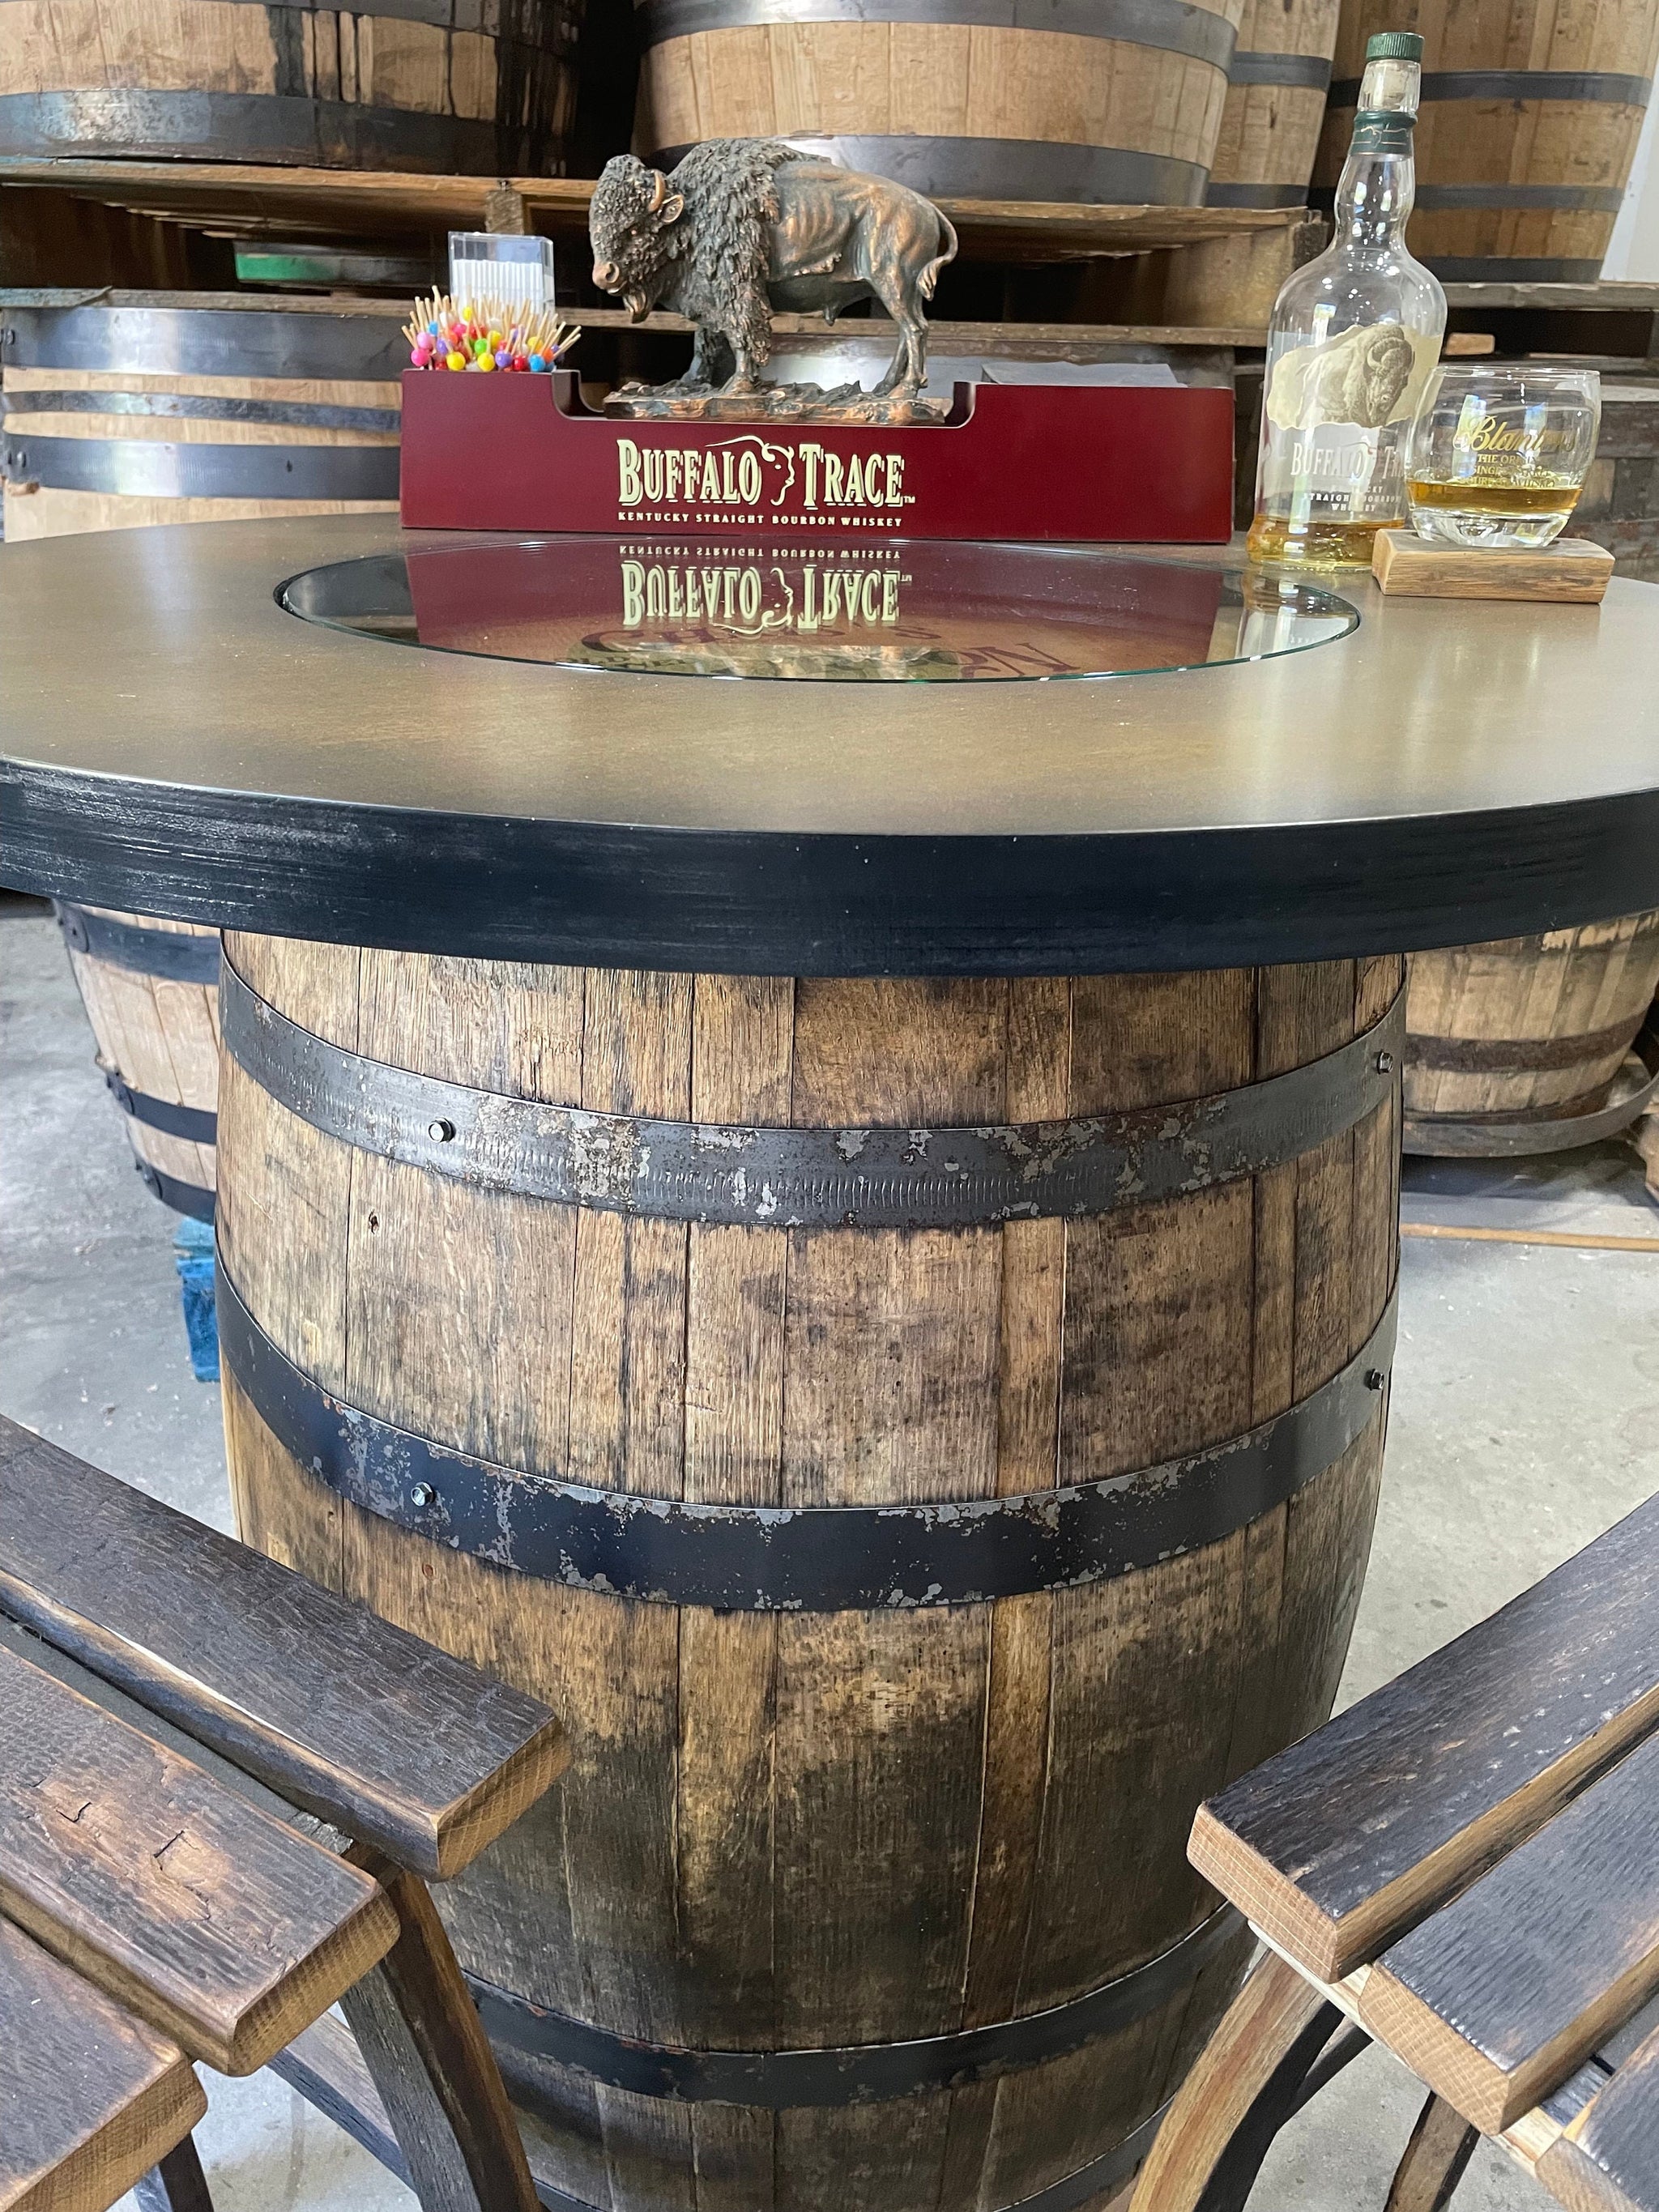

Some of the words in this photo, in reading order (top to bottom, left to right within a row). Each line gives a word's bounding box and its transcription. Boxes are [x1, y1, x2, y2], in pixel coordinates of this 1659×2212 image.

[616, 439, 762, 506] BUFFALO
[800, 443, 905, 510] TRACE
[1290, 442, 1367, 479] BUFFALO
[618, 512, 689, 522] KENTUCKY
[696, 514, 764, 524] STRAIGHT
[772, 515, 835, 526] BOURBON
[841, 517, 902, 526] WHISKEY
